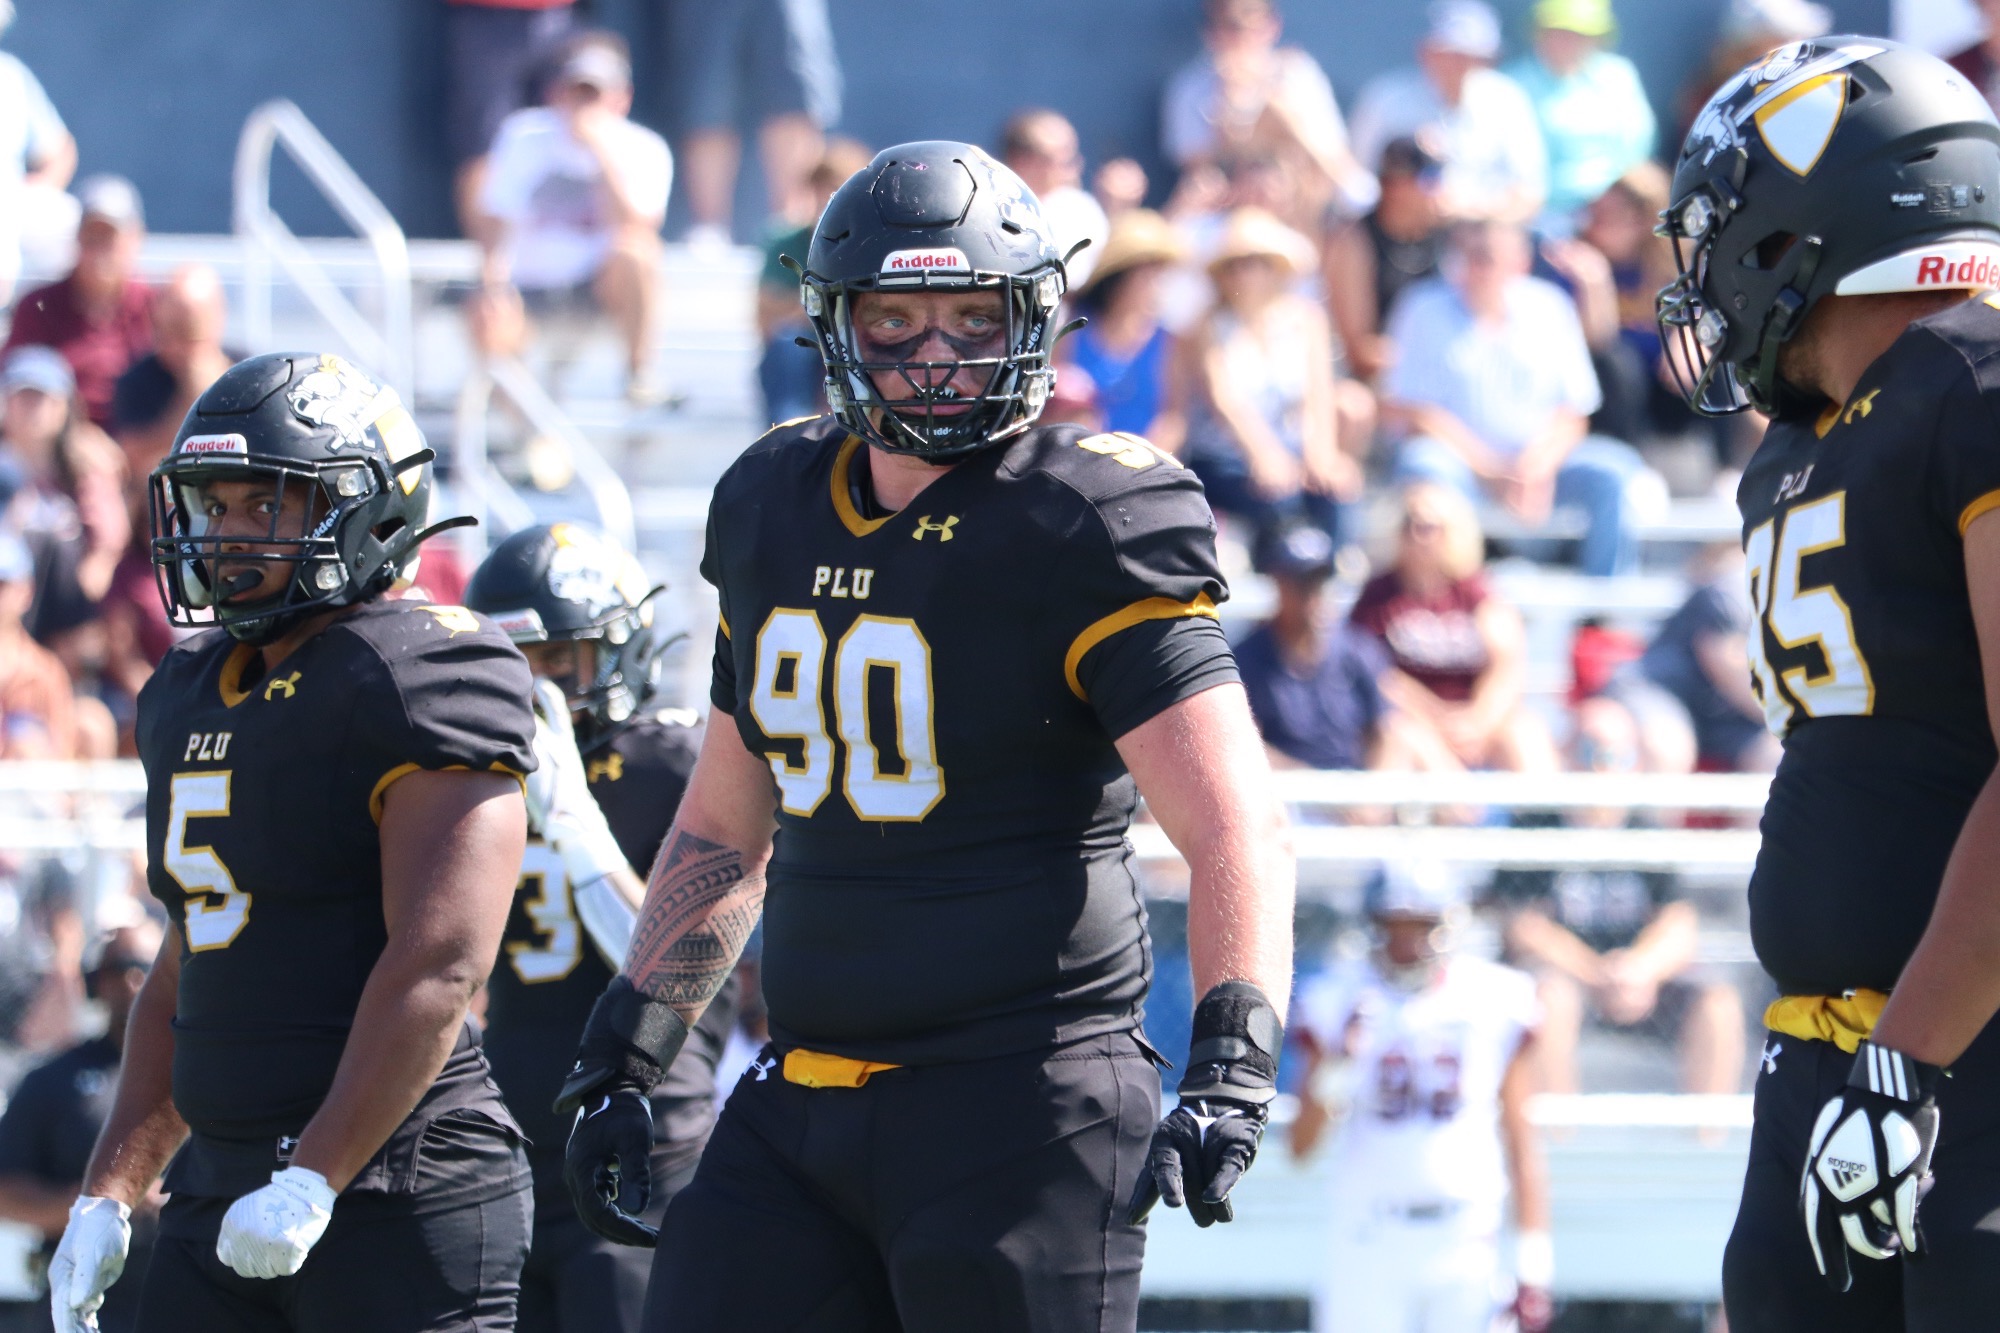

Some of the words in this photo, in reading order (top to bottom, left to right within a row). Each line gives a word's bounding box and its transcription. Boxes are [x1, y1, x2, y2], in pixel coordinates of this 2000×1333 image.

[891, 255, 958, 269] Riddell
[1917, 254, 2000, 286] Ridde
[185, 440, 236, 452] Riddell
[1773, 464, 1815, 505] PLU
[812, 565, 874, 600] PLU
[749, 606, 946, 822] 90
[184, 732, 233, 762] PLU
[163, 769, 252, 953] 5
[1828, 1157, 1867, 1172] adidas
